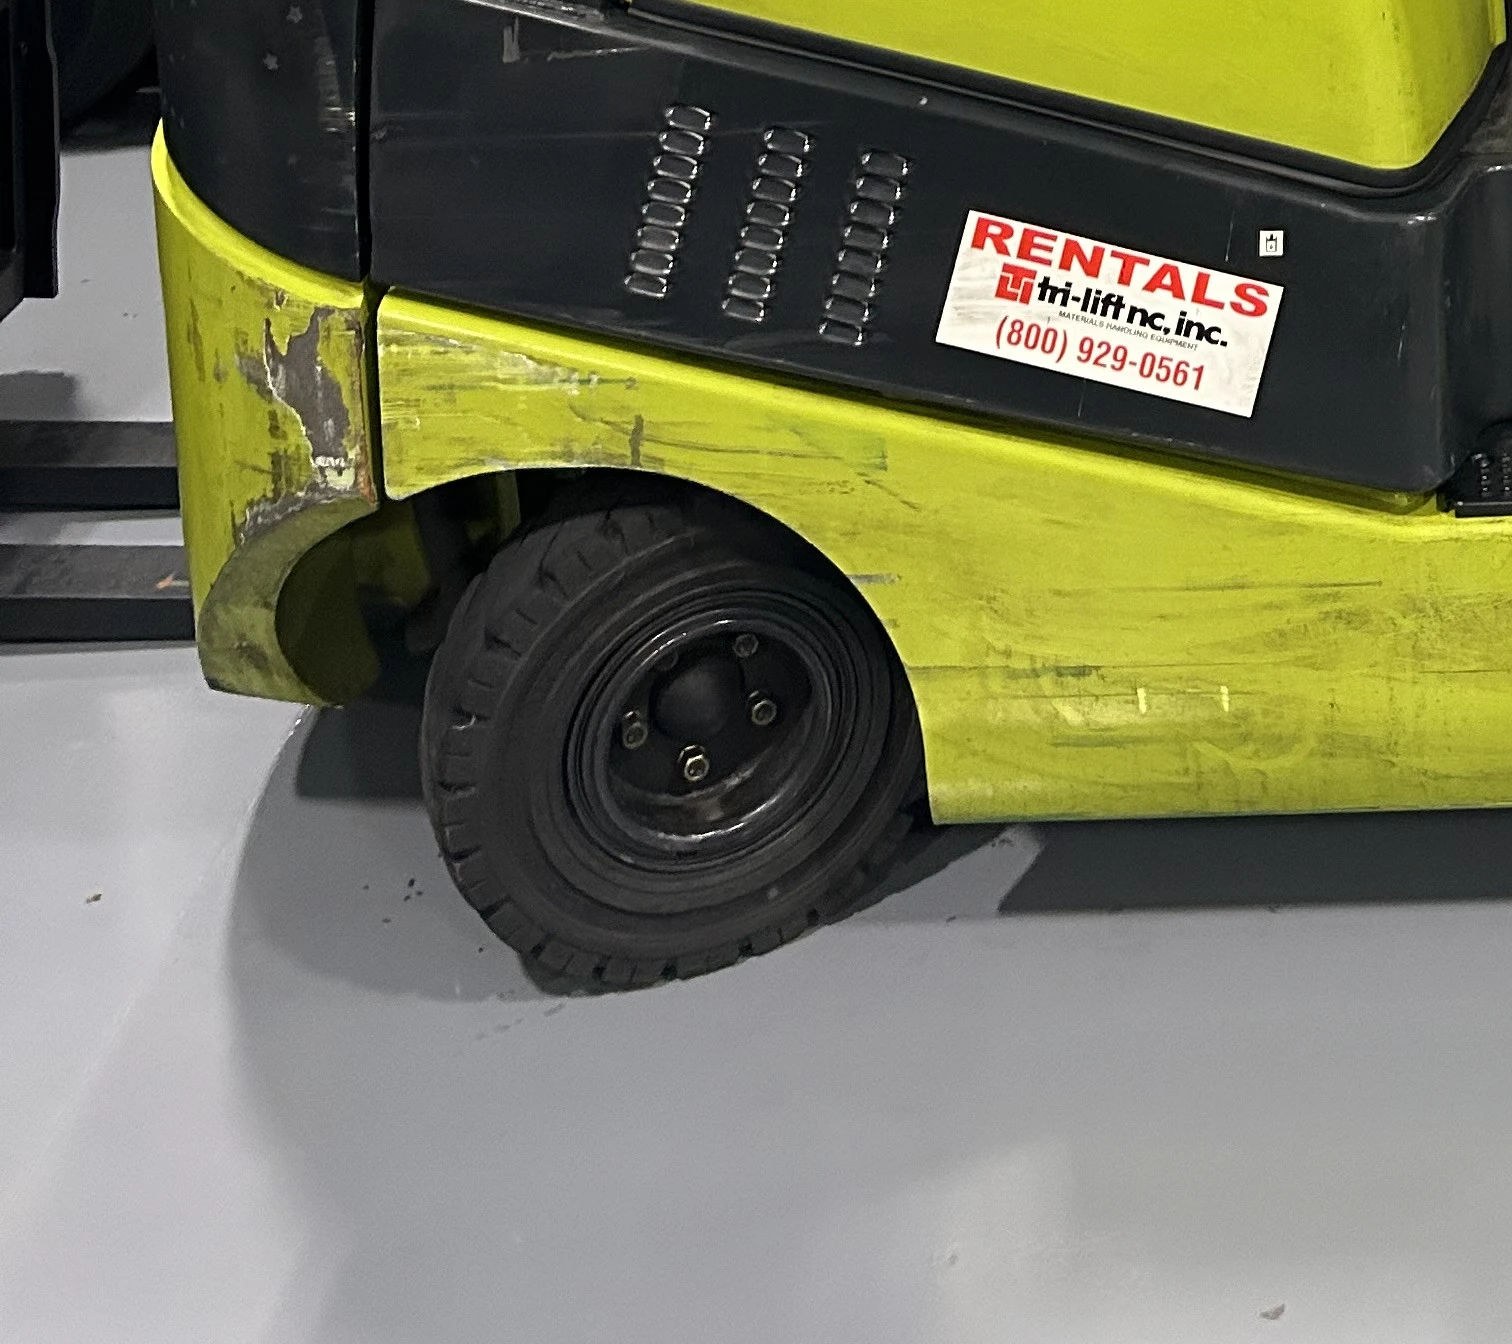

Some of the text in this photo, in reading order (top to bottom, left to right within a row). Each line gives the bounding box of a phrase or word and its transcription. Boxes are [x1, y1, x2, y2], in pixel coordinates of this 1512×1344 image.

[971, 217, 1269, 318] RENTALS
[1037, 275, 1228, 348] tri-lift nc, inc.
[1058, 310, 1105, 329] MATERIALS
[995, 315, 1206, 392] (800) 929-0561
